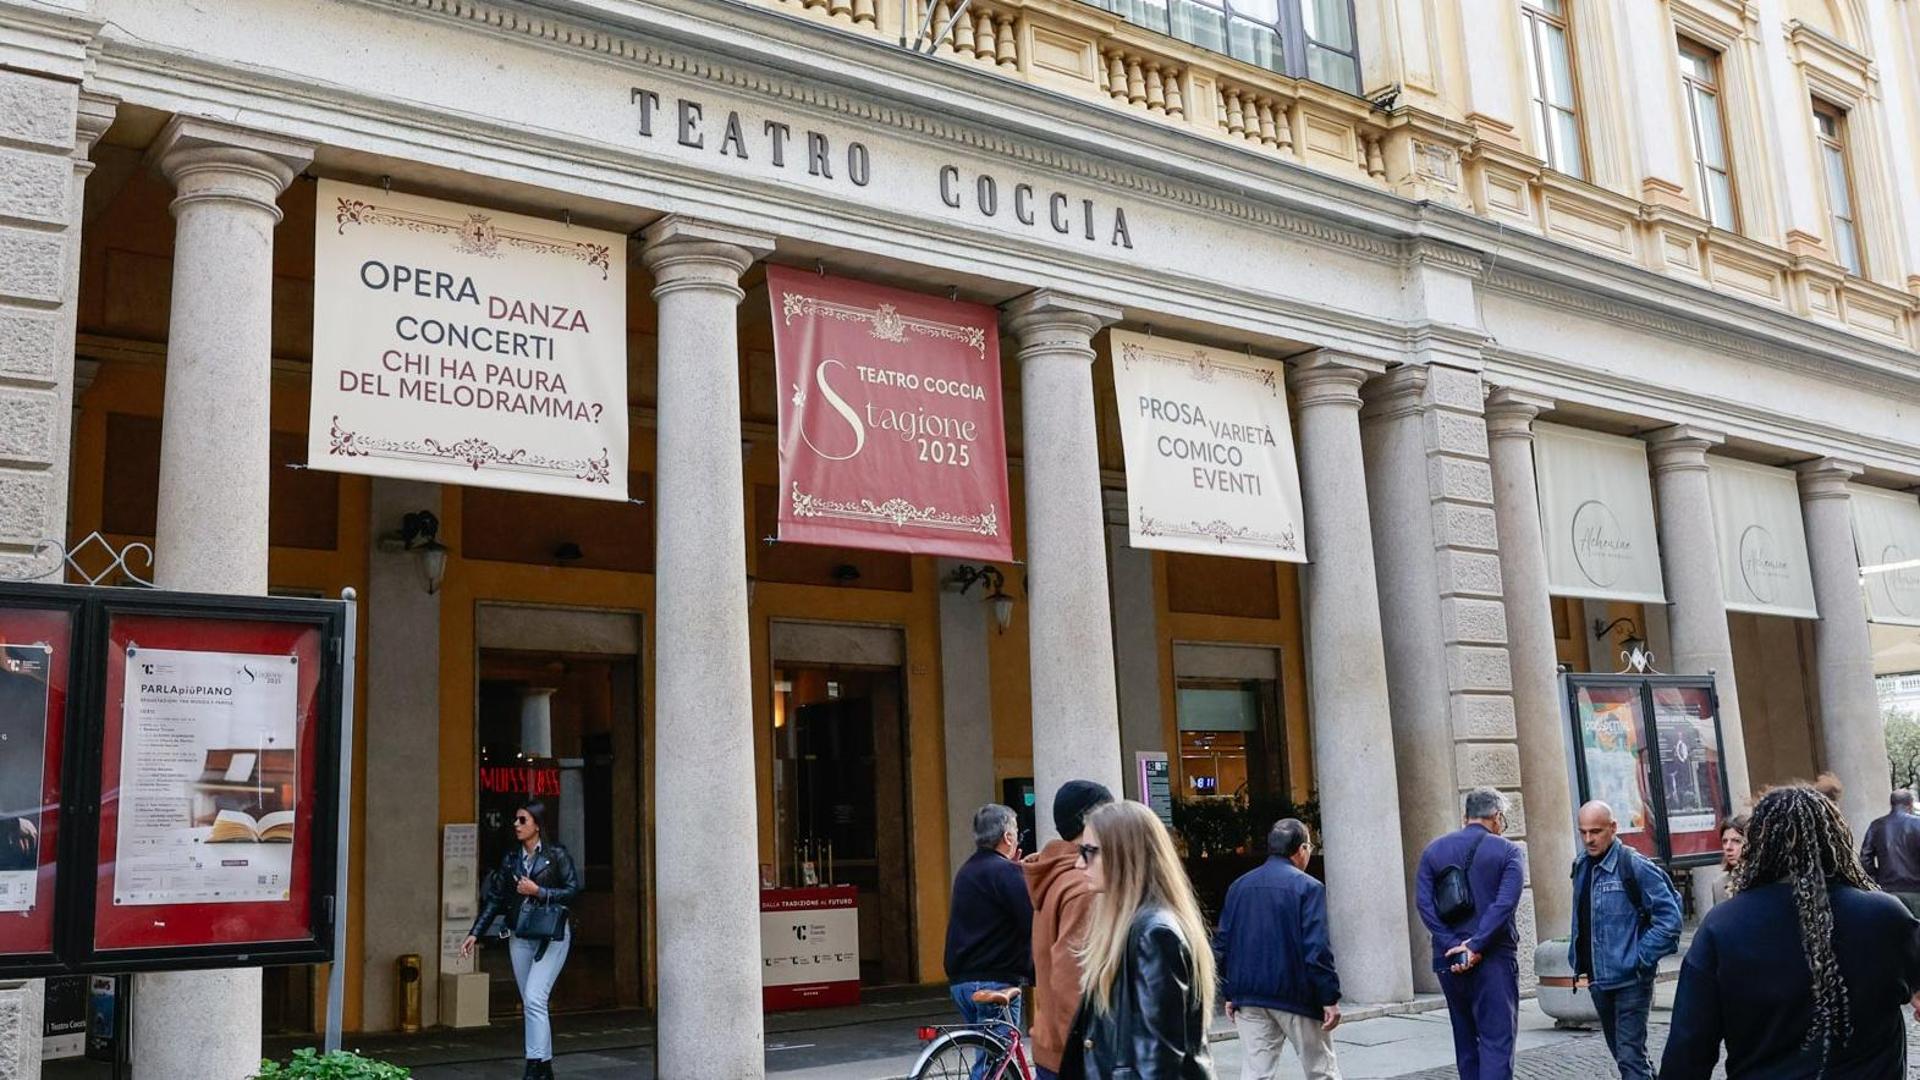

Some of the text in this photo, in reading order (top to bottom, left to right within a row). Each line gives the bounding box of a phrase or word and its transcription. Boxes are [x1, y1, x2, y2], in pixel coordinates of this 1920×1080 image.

[631, 87, 1133, 249] TEATRO COCCIA
[360, 260, 589, 333] OPERA DANZA
[395, 315, 554, 361] CONCERTI
[382, 350, 567, 394] CHI HA PAURA
[856, 366, 986, 401] TEATRO COCCIA
[339, 370, 603, 423] DEL MELODRAMMA?
[800, 359, 978, 461] Stagione
[1139, 396, 1276, 447] PROSA VARIETÀ
[918, 438, 971, 467] 2025
[1157, 435, 1243, 467] COMICO
[1192, 467, 1262, 496] EVENTI
